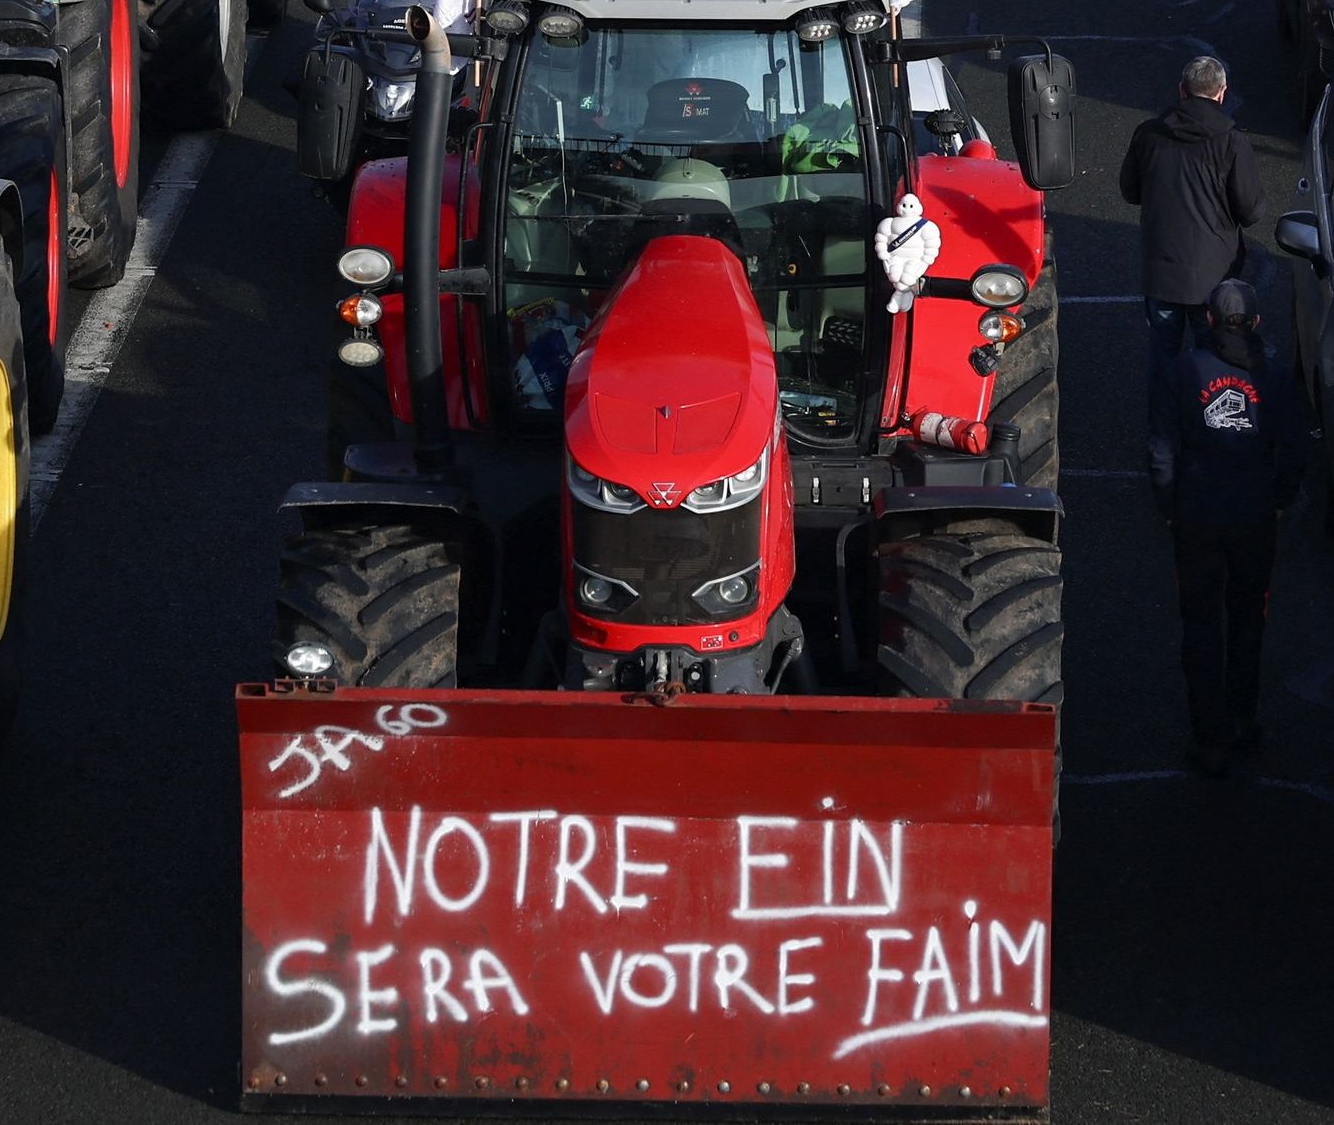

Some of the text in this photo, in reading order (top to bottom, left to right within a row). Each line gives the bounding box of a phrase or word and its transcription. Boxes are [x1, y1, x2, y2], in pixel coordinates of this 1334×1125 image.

[363, 804, 677, 925] NOTRE
[264, 937, 530, 1046] SERA
[579, 936, 823, 1017] VOTRE
